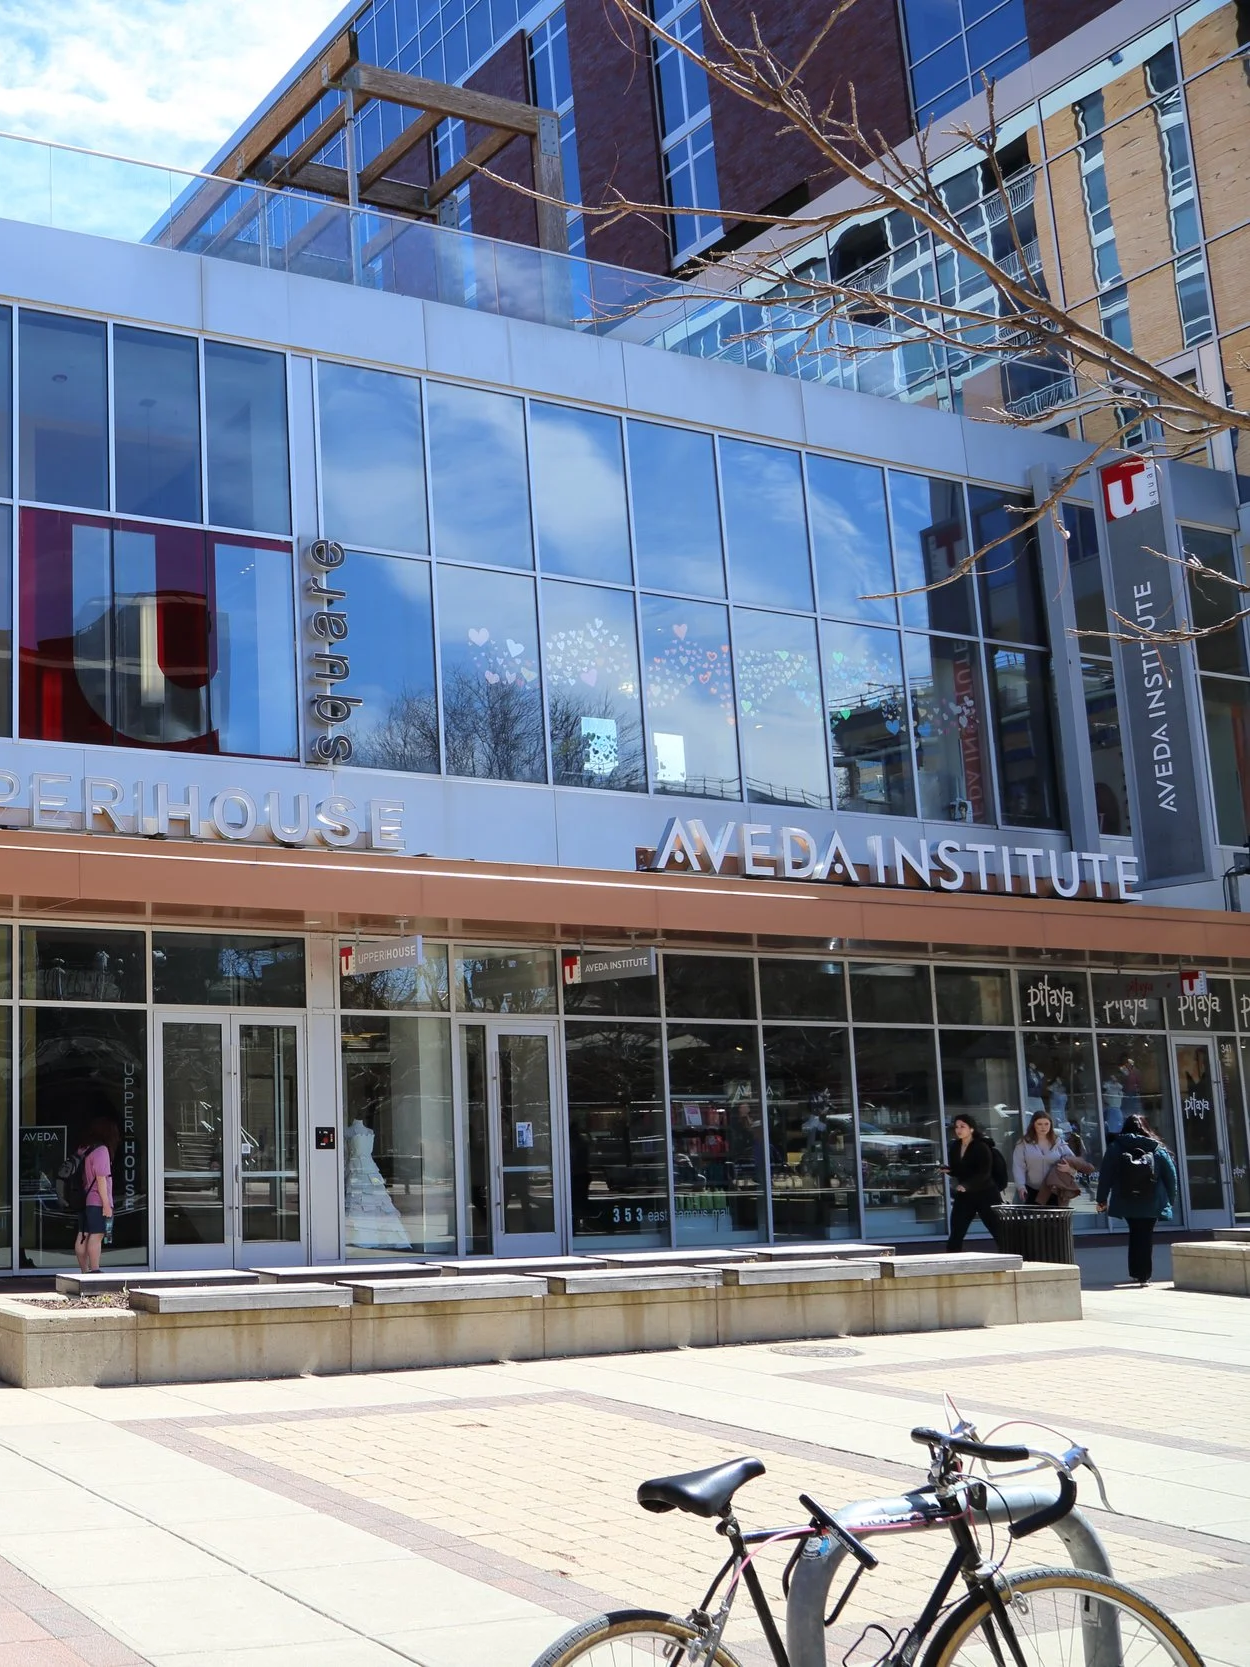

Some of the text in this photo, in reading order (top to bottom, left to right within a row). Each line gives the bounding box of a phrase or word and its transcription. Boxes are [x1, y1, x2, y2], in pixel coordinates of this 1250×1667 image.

[309, 538, 363, 764] square
[1133, 581, 1178, 813] AVEDA INSTITUTE
[655, 816, 1143, 901] AVEDA INSTITUTE
[585, 962, 608, 973] AVEDA
[610, 957, 648, 970] INSTITUTE
[1027, 974, 1075, 1023] pitaya
[1185, 1091, 1210, 1120] pitaya
[23, 1132, 59, 1141] AVEDA
[648, 1209, 668, 1221] east
